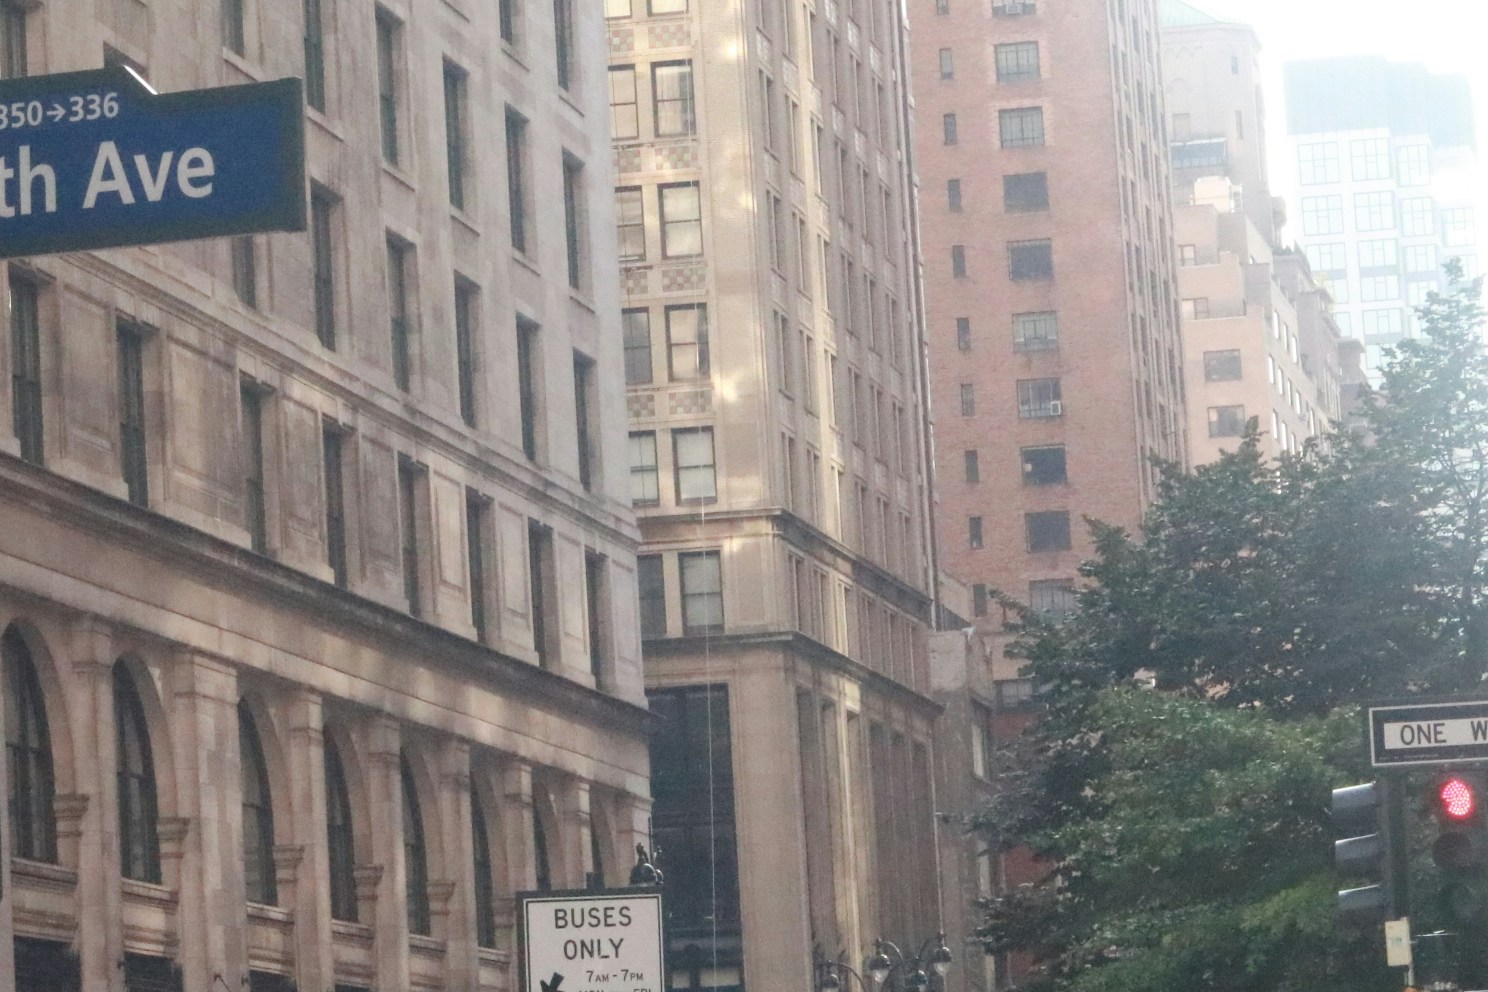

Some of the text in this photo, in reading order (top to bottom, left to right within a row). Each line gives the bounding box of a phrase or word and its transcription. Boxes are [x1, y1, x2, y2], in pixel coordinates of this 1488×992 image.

[69, 92, 119, 122] 336
[83, 141, 215, 208] Ave
[1400, 722, 1447, 746] ONE
[554, 906, 632, 929] BUSES
[563, 938, 624, 960] ONLY
